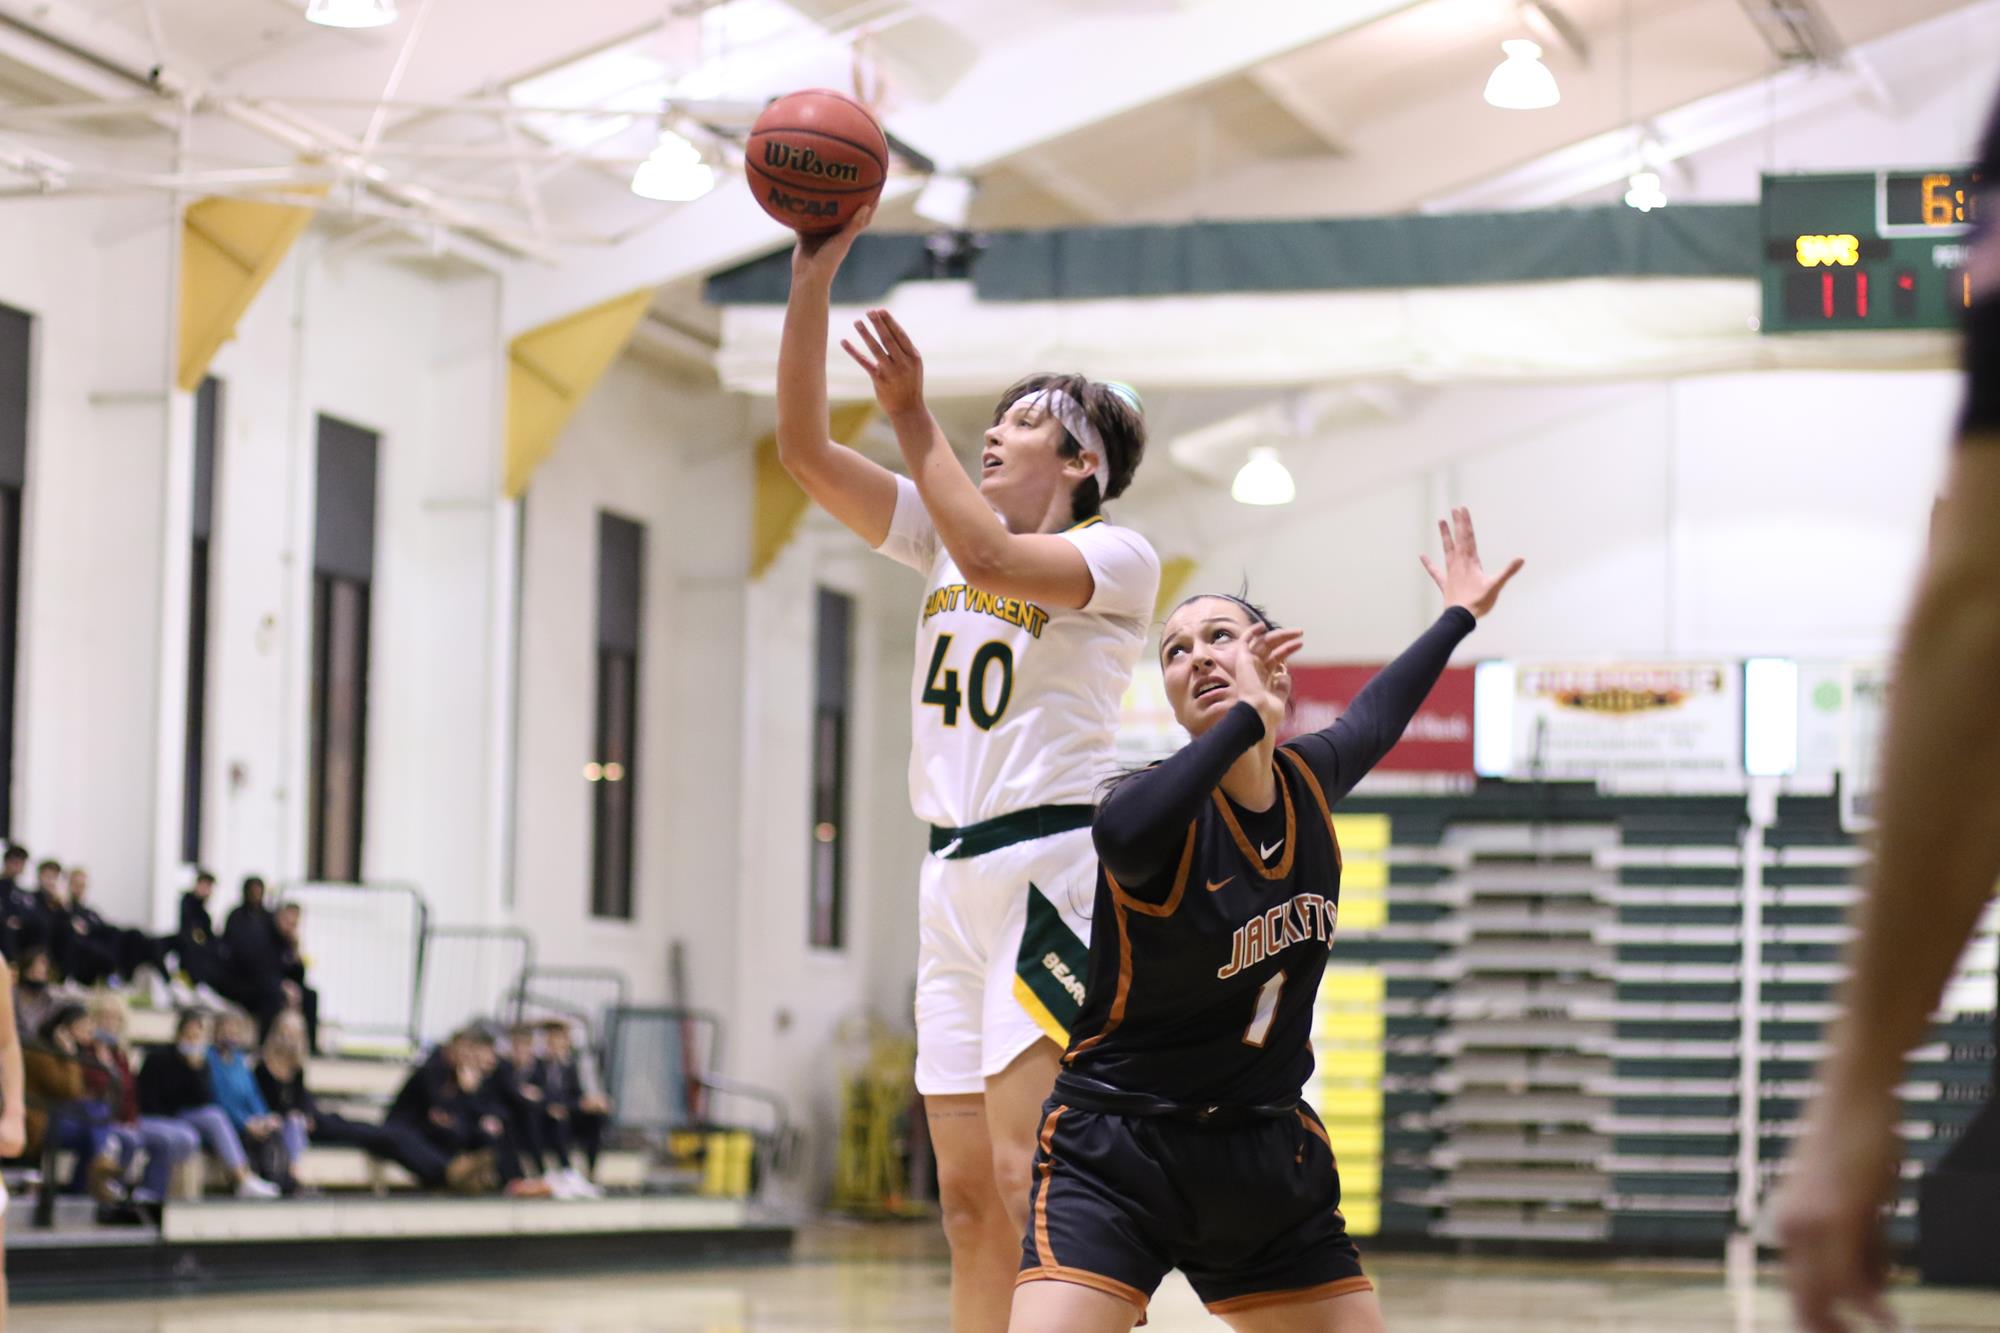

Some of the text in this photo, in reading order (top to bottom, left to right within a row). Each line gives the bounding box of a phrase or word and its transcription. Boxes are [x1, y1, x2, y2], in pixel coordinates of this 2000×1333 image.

[764, 141, 859, 182] Wilson
[767, 186, 839, 216] NCAA
[1921, 173, 1974, 227] 6:
[1821, 271, 1869, 319] 11
[922, 584, 1049, 639] AINT VINCENT
[921, 632, 1014, 732] 40
[1216, 892, 1338, 980] JACKETS
[1241, 968, 1288, 1048] 1
